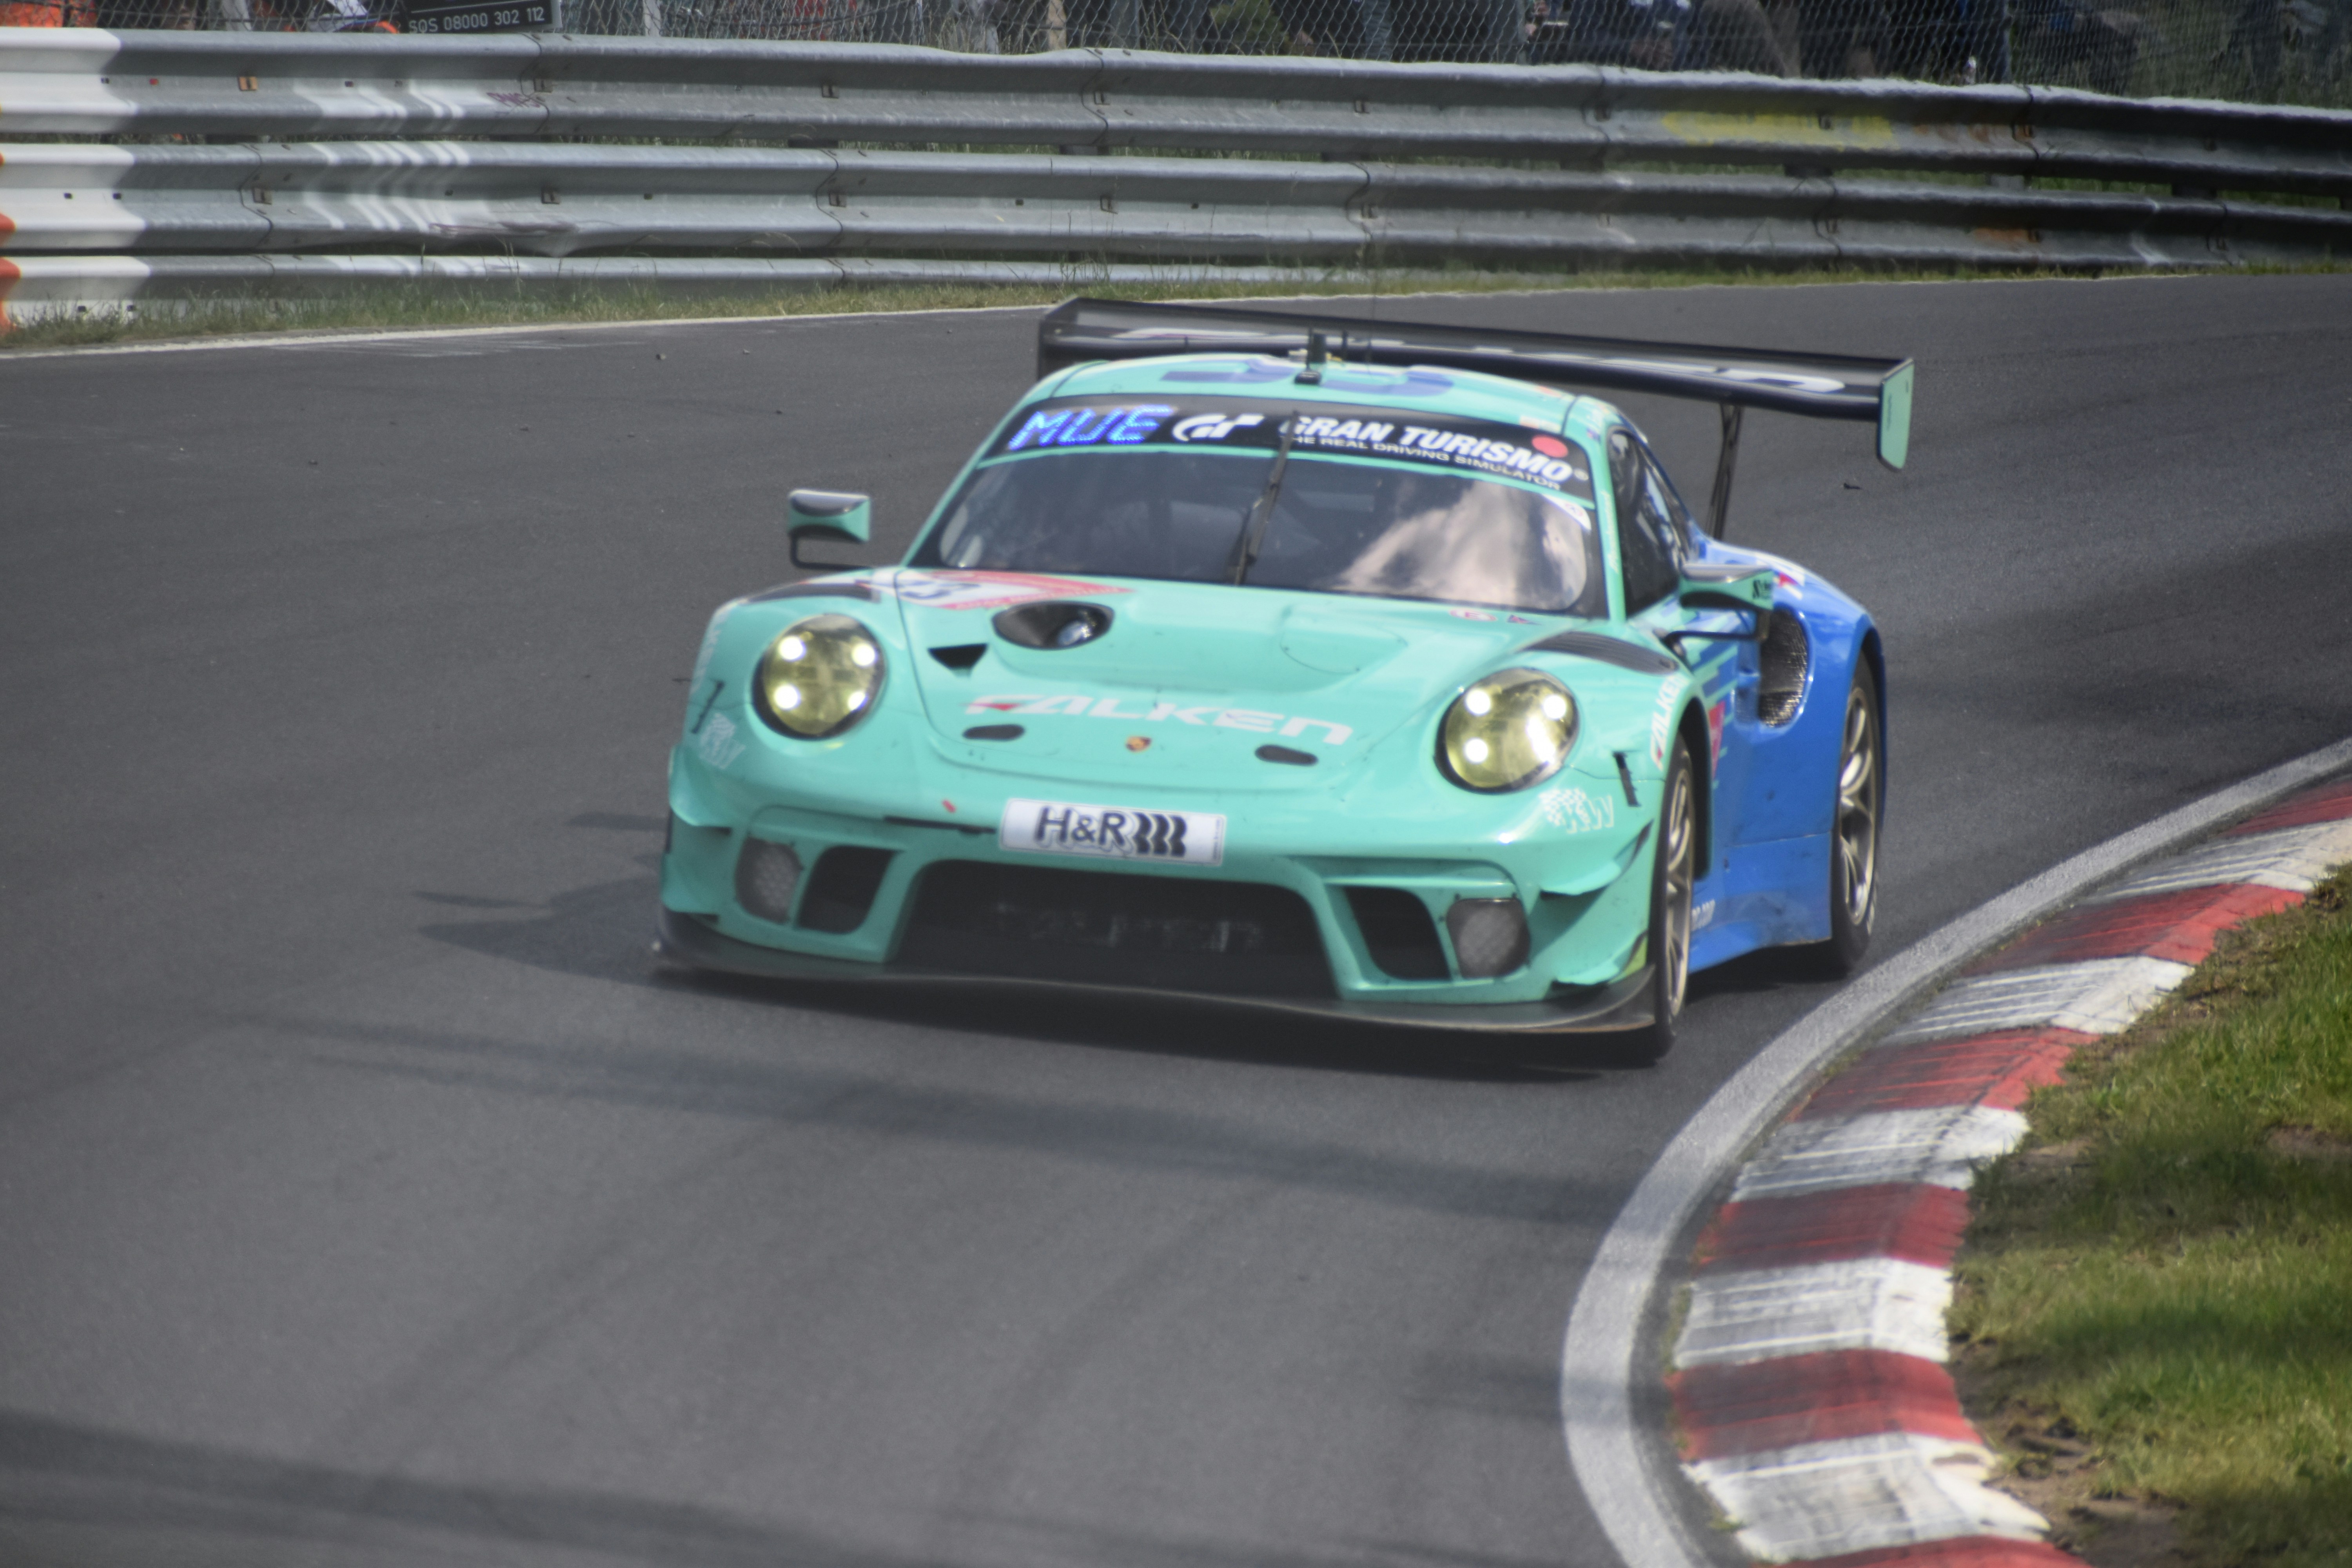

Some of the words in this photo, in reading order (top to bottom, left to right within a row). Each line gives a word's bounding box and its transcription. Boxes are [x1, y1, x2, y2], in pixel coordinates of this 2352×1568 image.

[443, 13, 488, 31] 08000
[494, 9, 520, 25] 302
[527, 6, 544, 22] 112
[1008, 405, 1174, 450] MUE
[1279, 416, 1394, 442] GRAN
[1399, 426, 1573, 481] TURISMO
[1321, 437, 1368, 449] REAL
[1373, 443, 1450, 461] DRIVING
[1454, 455, 1561, 490] SIMULATOR
[964, 694, 1353, 745] FALKEN
[1033, 805, 1127, 847] H&R
